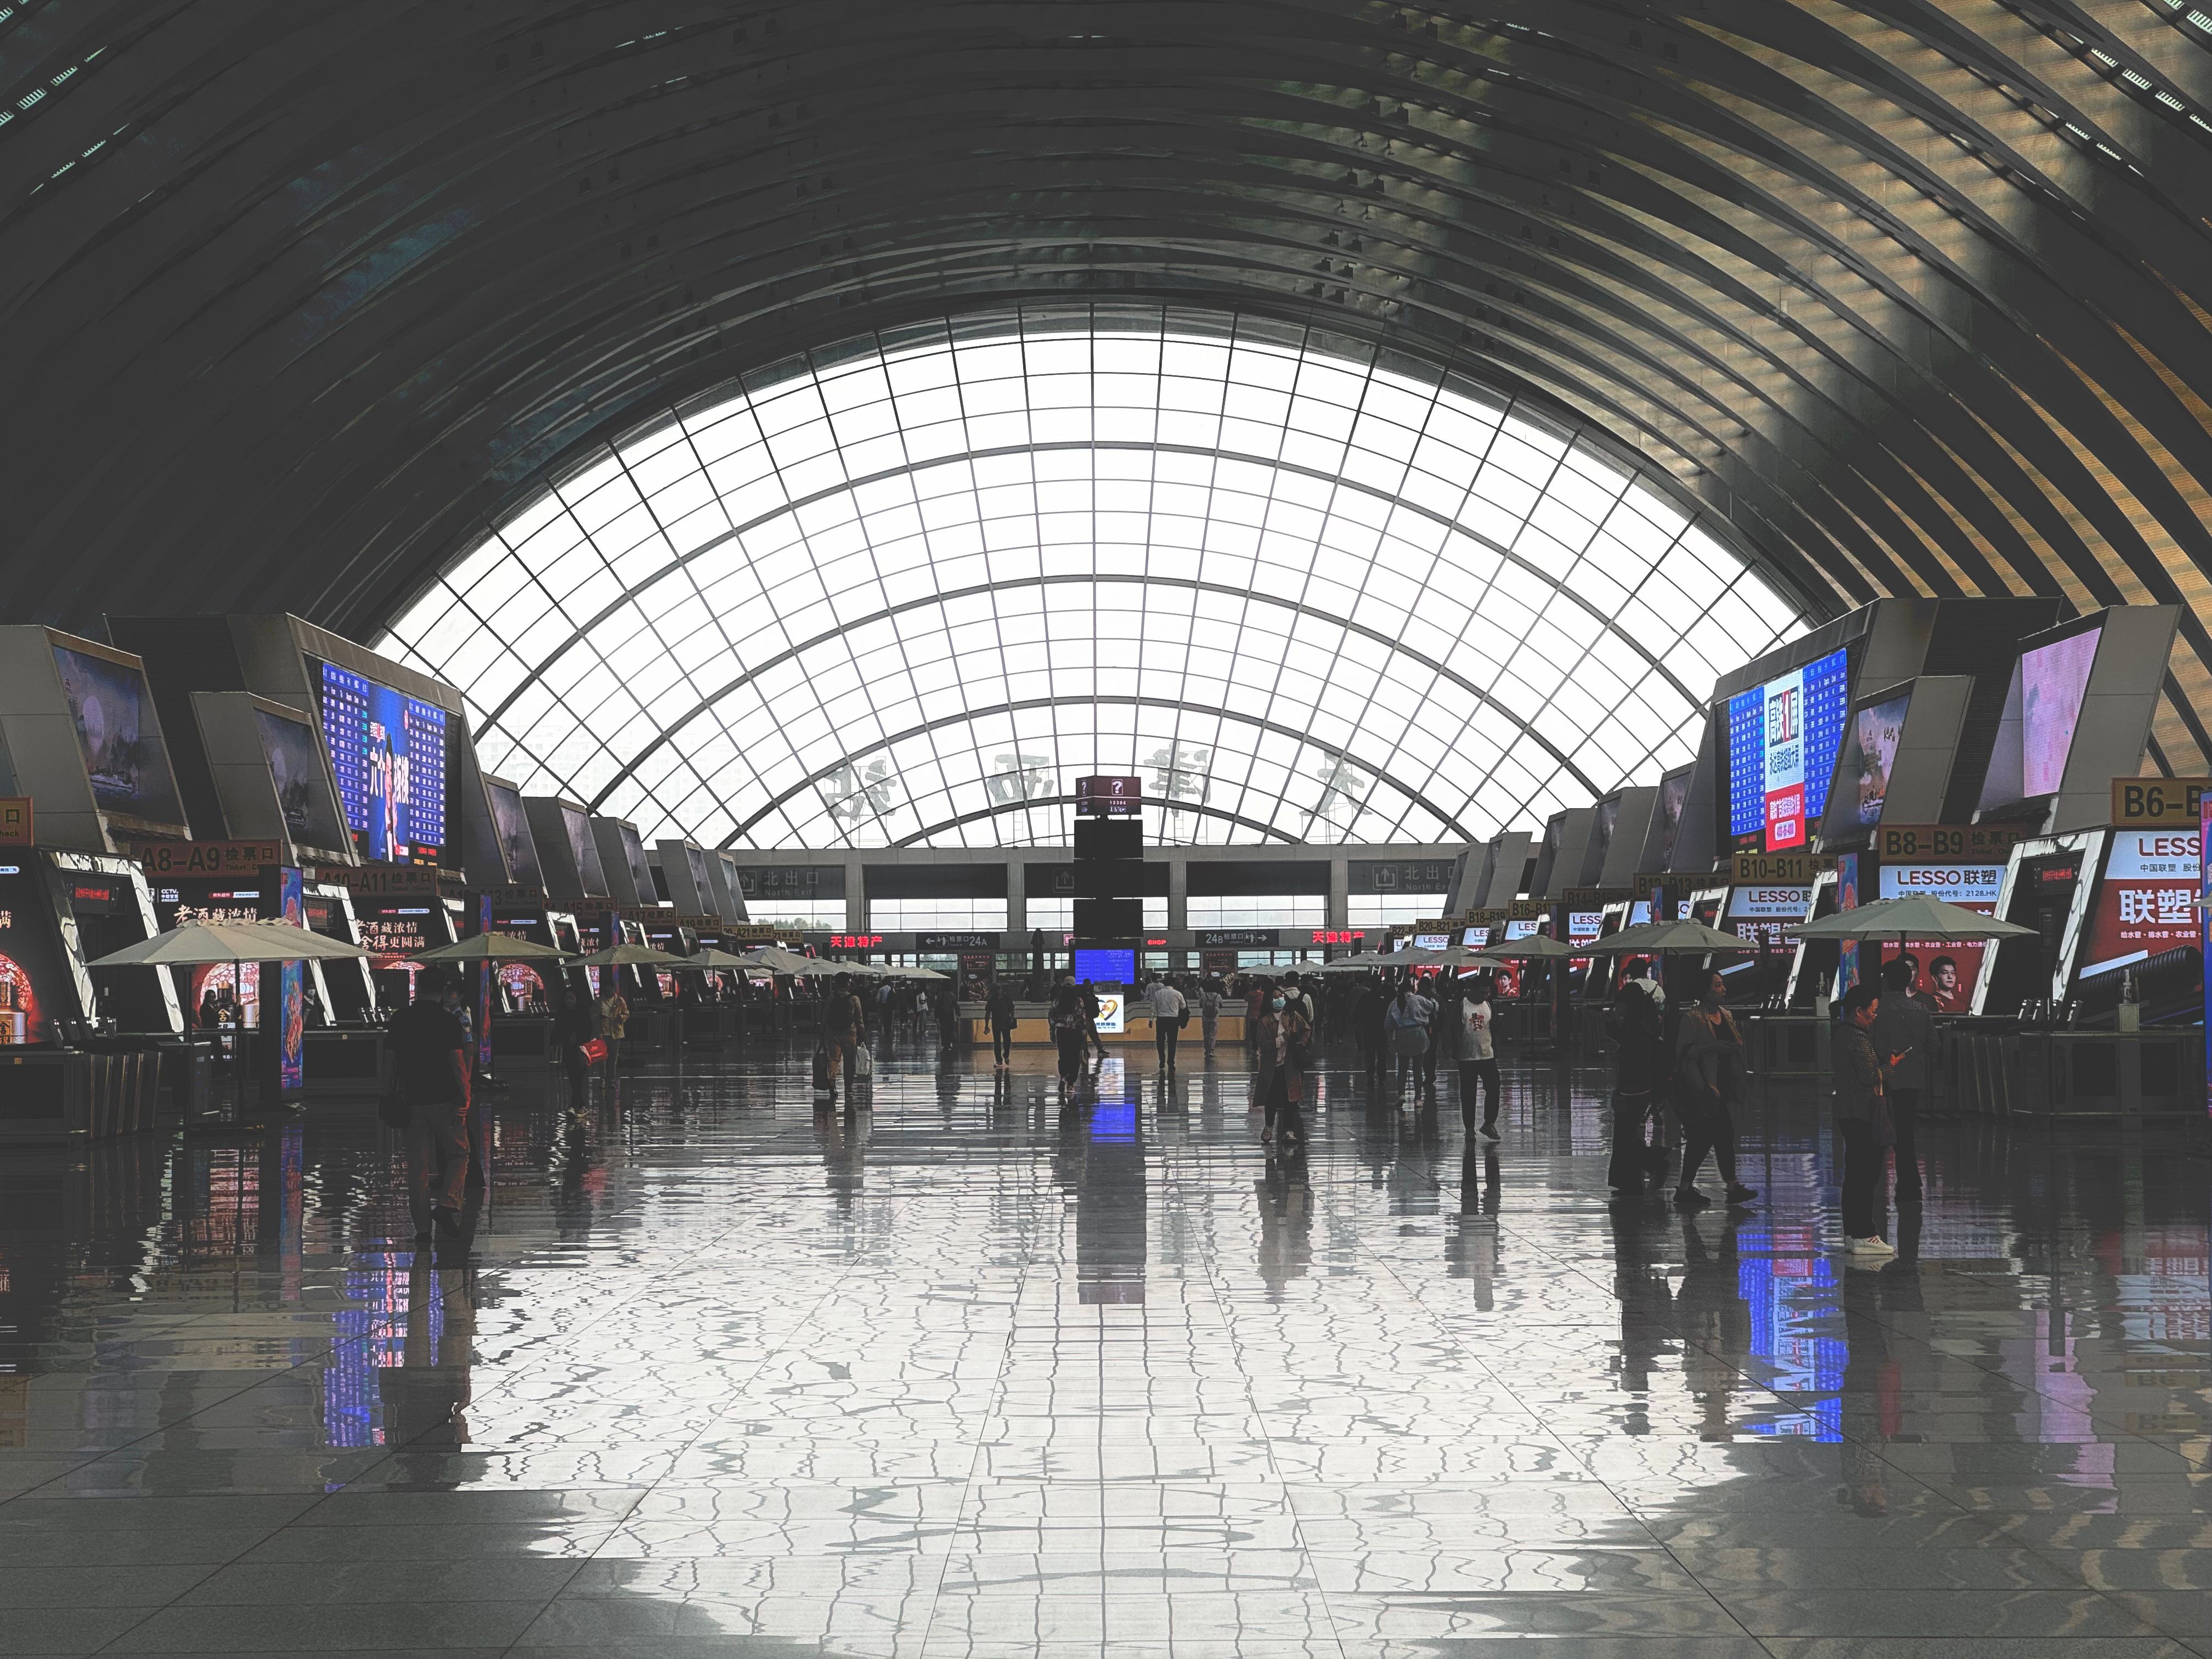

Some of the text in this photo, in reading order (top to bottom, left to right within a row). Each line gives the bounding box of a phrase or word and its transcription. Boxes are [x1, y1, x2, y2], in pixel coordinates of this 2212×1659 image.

[2125, 785, 2201, 818] B6-B
[1886, 831, 1964, 856] B8-B9
[2138, 837, 2201, 857] LESS
[225, 847, 273, 861] 检票口
[1740, 858, 1802, 878] B10-B11
[2140, 864, 2176, 872] 中国联塑
[764, 871, 819, 886] 北出口
[1897, 870, 1997, 885] LESSO 联塑
[1749, 890, 1801, 903] LESSO
[2119, 889, 2202, 924] 联塑
[1572, 915, 1602, 924] LESS
[830, 935, 883, 949] 天津特产
